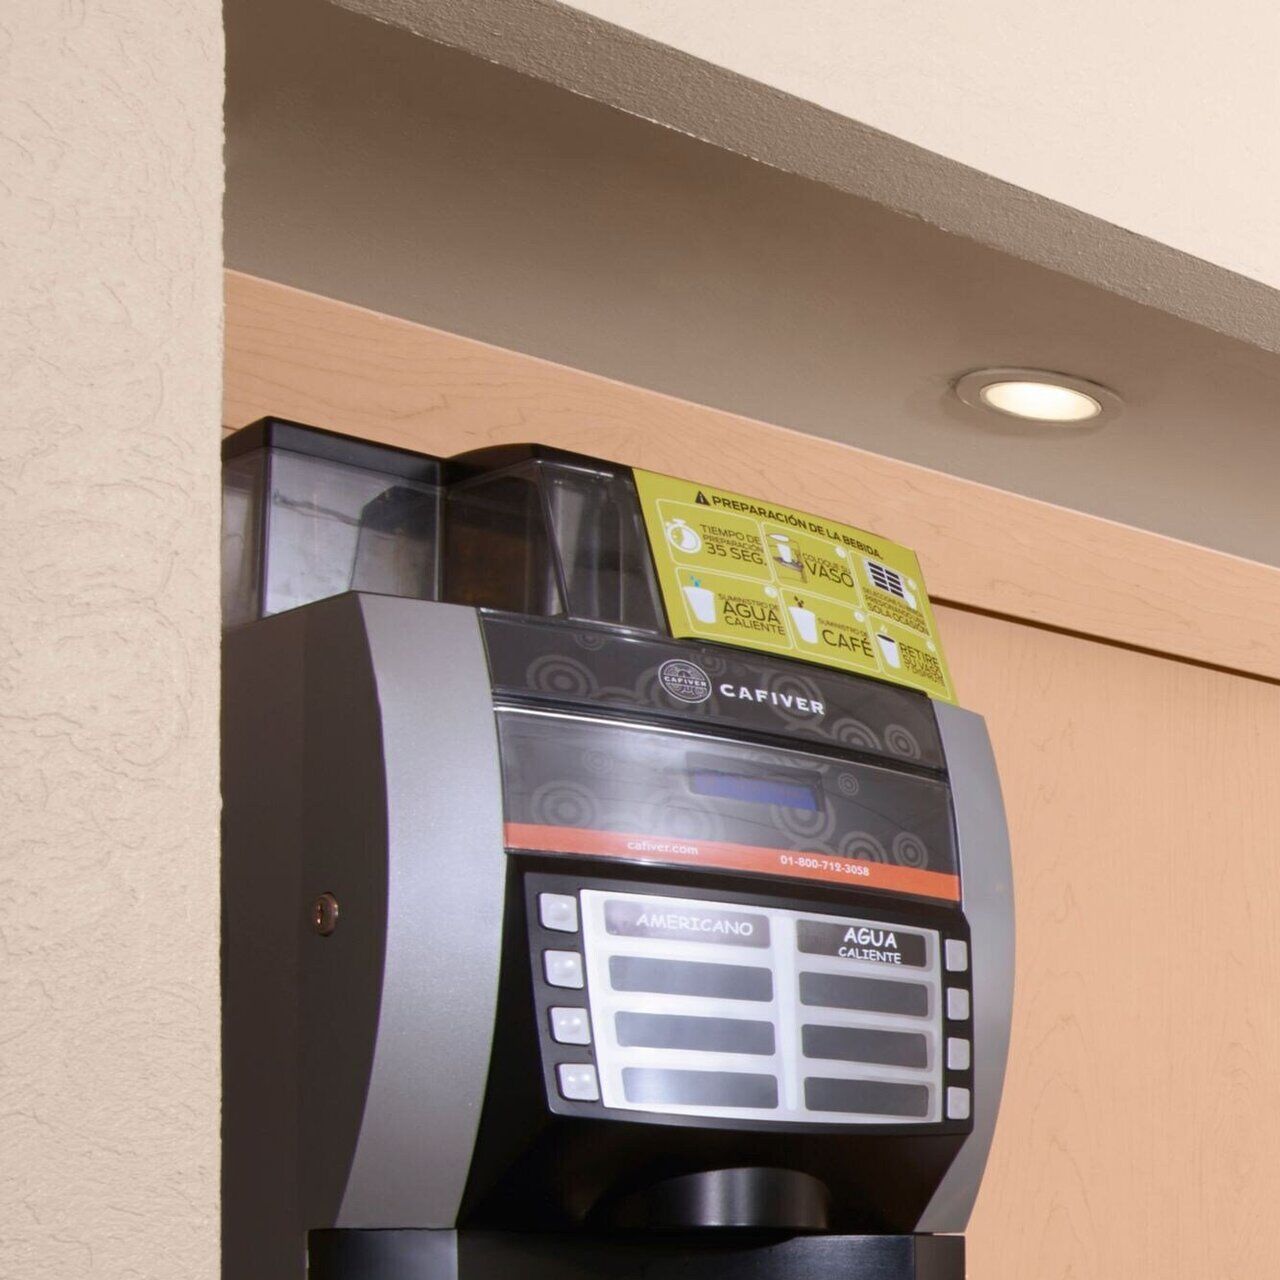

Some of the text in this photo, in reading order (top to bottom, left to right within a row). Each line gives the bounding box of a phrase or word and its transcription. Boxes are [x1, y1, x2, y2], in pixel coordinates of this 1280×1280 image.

[712, 495, 807, 530] PREPARACIÓN
[809, 522, 825, 535] DE
[826, 529, 841, 542] LA
[700, 524, 762, 545] TIEMPO DE
[705, 542, 767, 566] 35 SEG.
[804, 560, 854, 588] VASO
[723, 601, 781, 625] AGUA
[724, 616, 786, 636] CALIENTE
[822, 629, 874, 658] CAFÉ
[898, 642, 938, 665] RETIRE
[664, 676, 707, 687] CAFIVER
[720, 684, 825, 715] CAFIVER
[627, 840, 698, 856] cafiver.com
[780, 855, 870, 877] 01-800-712-3058
[636, 914, 753, 937] AMERICANO
[844, 927, 897, 949] AGUA
[838, 947, 902, 965] CALIENTE
